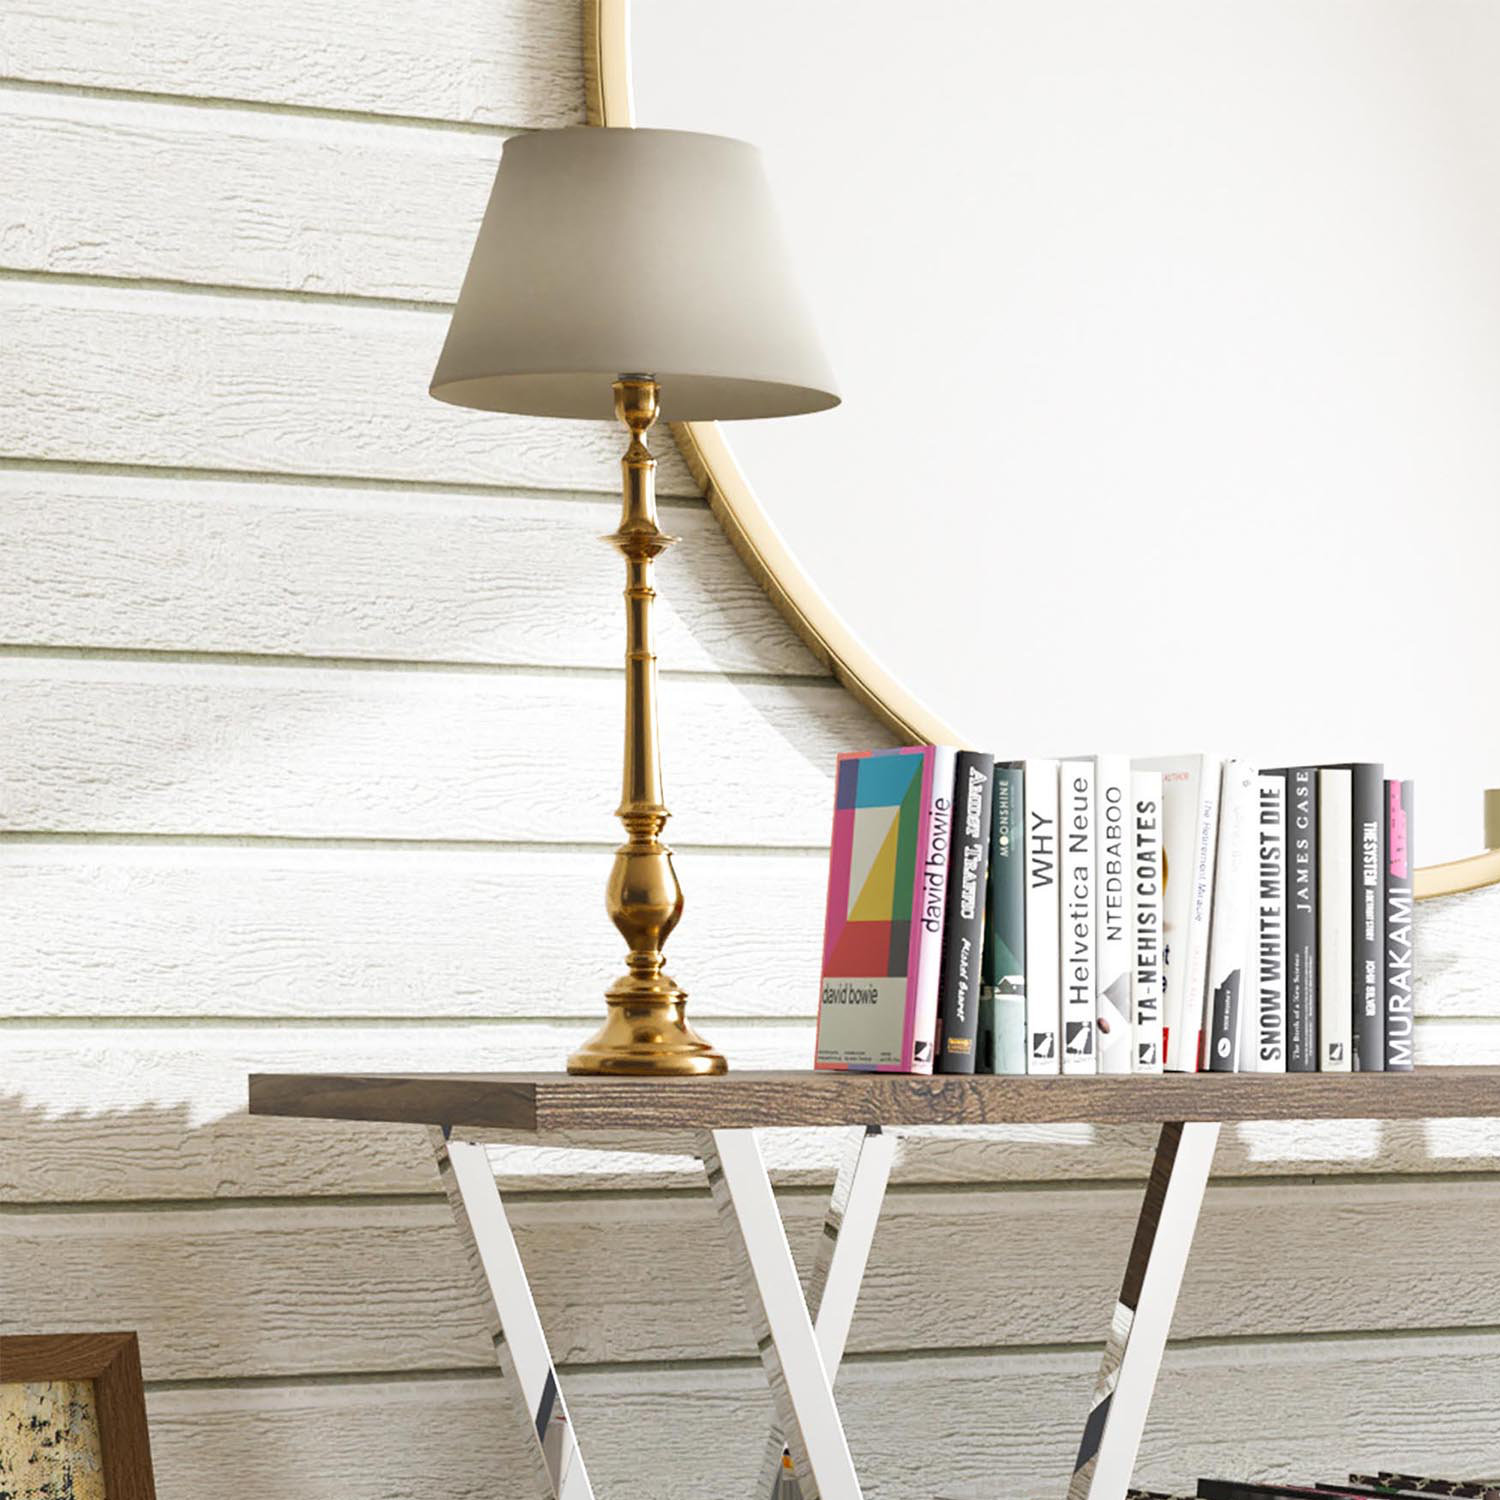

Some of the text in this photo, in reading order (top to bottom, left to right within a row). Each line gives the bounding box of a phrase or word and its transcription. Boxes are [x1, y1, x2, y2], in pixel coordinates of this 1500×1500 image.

[921, 797, 951, 933] david bowie
[1032, 811, 1053, 889] WHY
[1069, 777, 1090, 1004] Helvetica Neue
[1105, 786, 1123, 941] NTEDBABOO
[1136, 801, 1158, 1025] TA-NEHISI COATES
[1296, 771, 1311, 913] JAMES CASE
[1363, 842, 1377, 887] SYSTEM
[822, 982, 879, 1005] david bowie
[1259, 788, 1282, 1061] SNOW WHITE MUST DIE
[1365, 960, 1377, 1017] JOHN SILVER
[1388, 888, 1412, 1066] MURAKAMI
